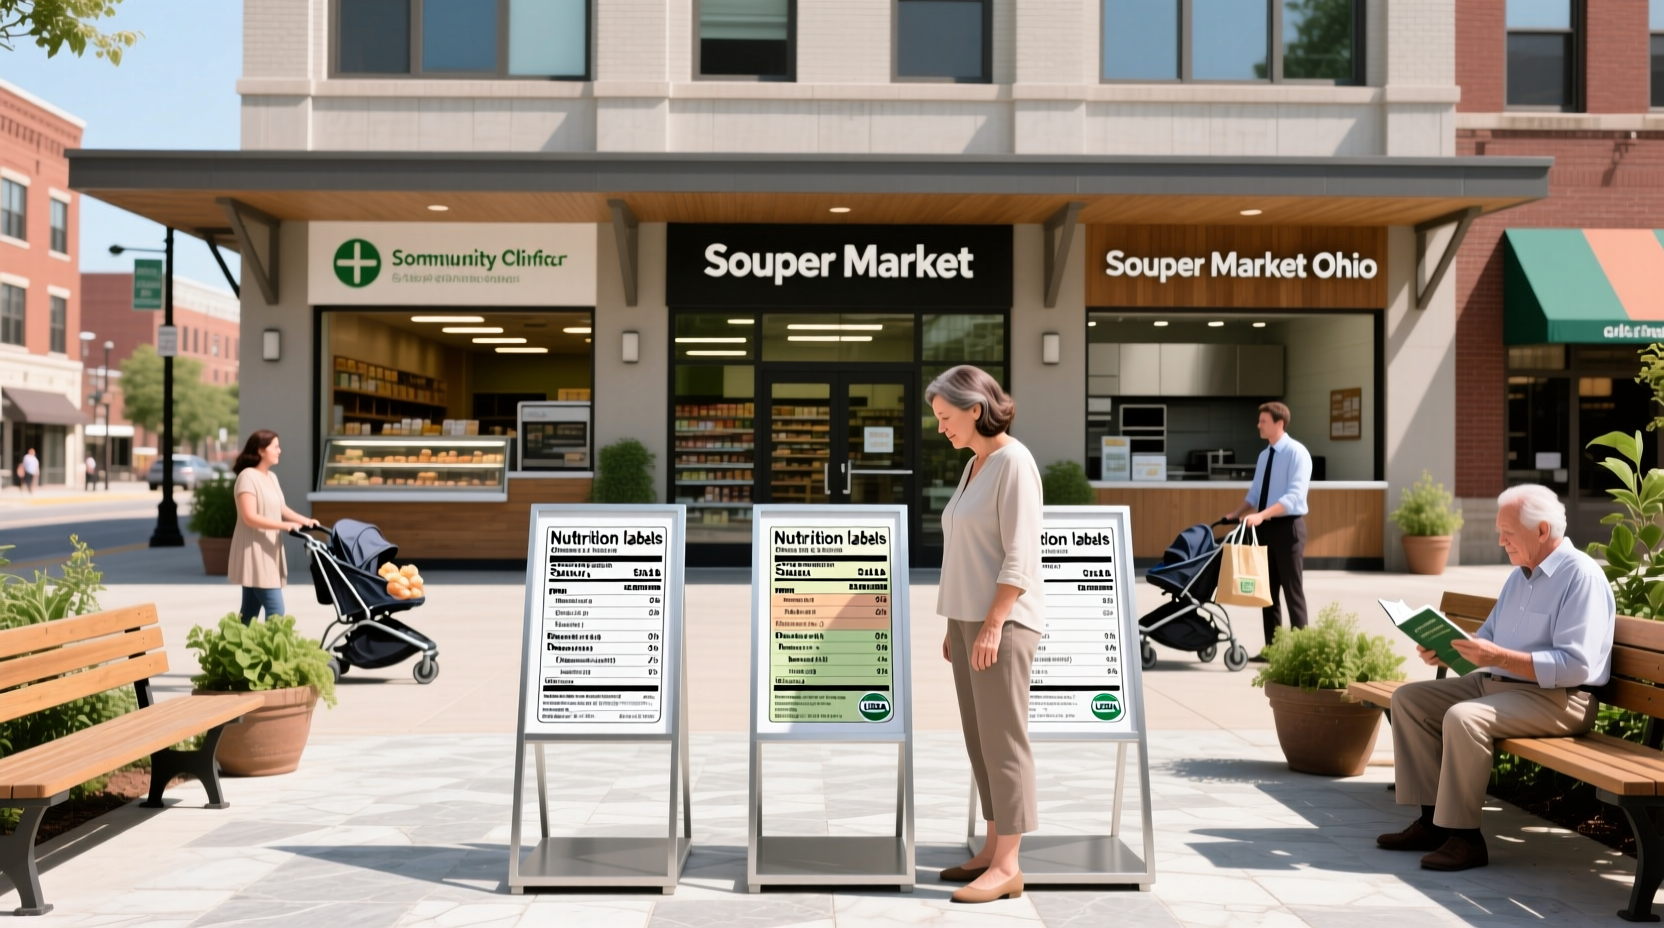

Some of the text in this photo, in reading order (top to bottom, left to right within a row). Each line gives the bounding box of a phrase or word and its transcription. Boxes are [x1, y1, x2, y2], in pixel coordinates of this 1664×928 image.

[703, 243, 974, 286] Souper Market
[1105, 250, 1378, 284] Souper Market Ohio
[774, 530, 844, 546] Nutrition
